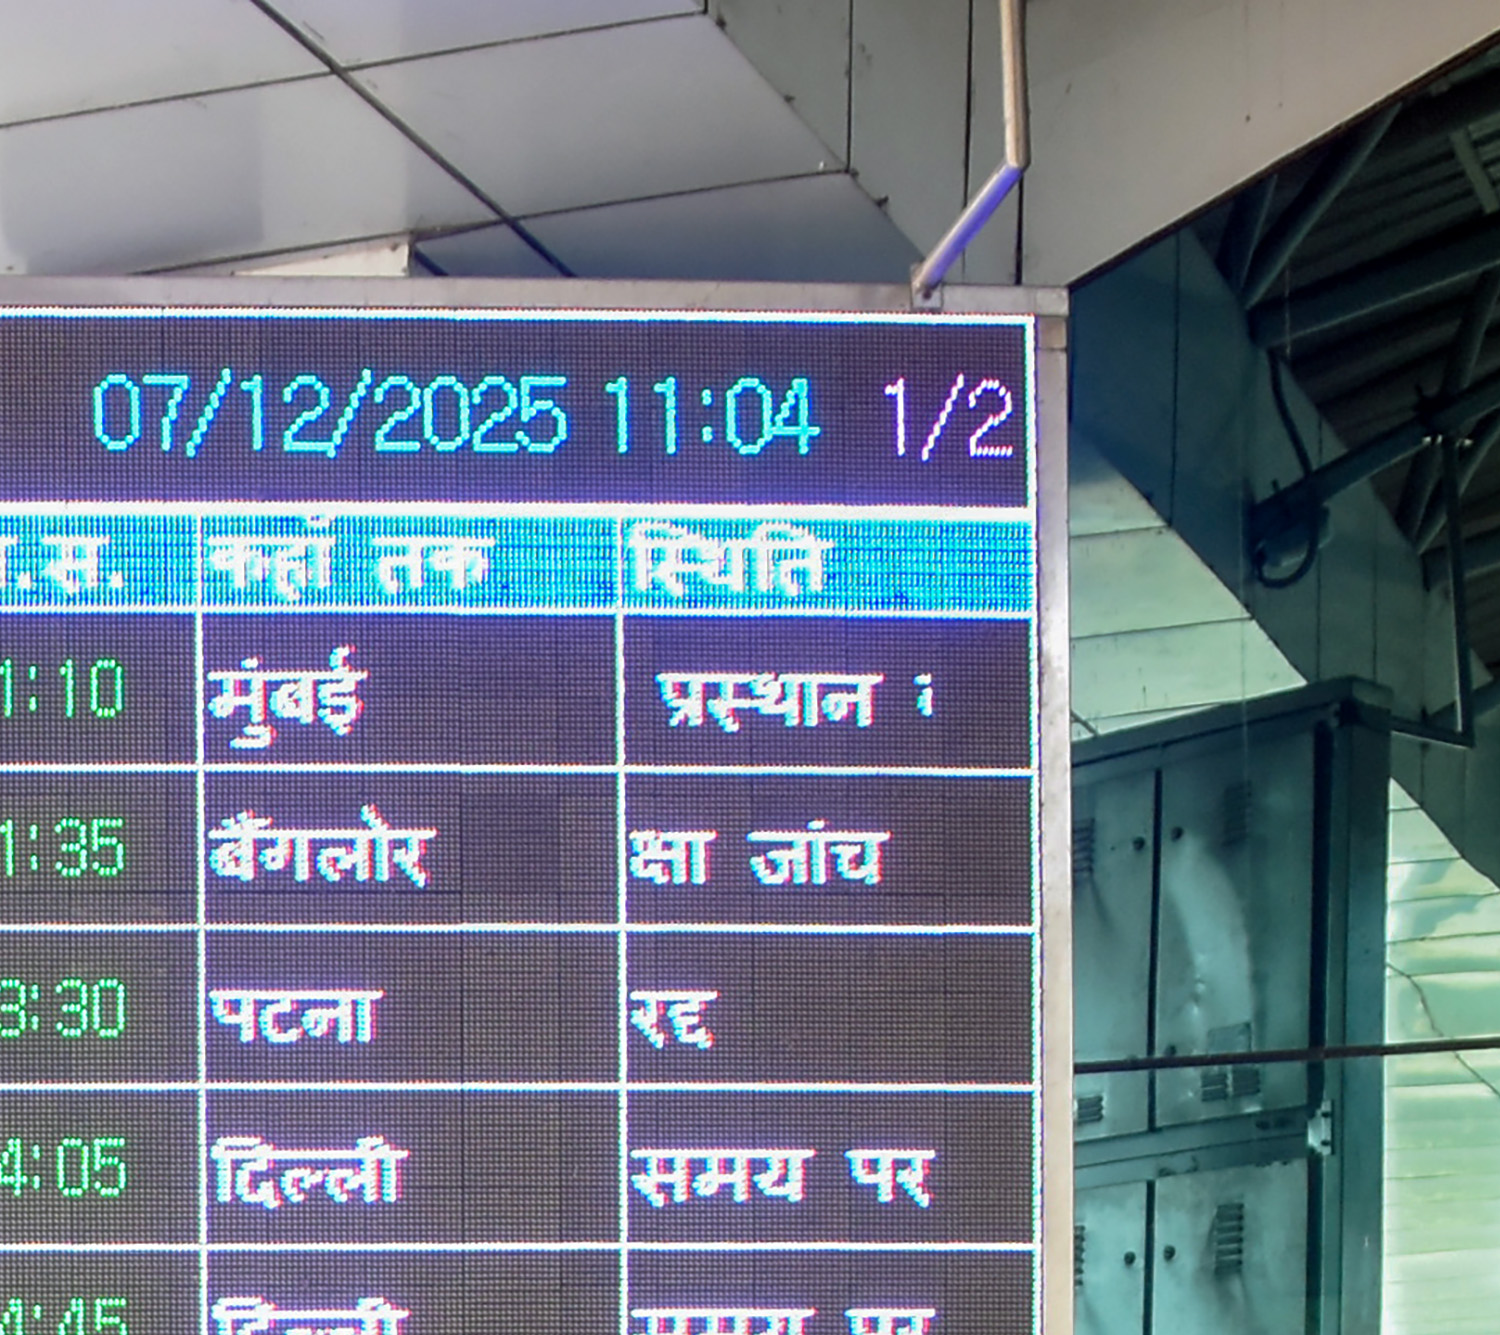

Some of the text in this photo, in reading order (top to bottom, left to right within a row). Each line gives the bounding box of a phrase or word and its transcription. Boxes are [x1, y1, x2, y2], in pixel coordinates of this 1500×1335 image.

[94, 370, 1012, 461] 07/12/2025 11:04 1/2
[371, 538, 495, 594] तक
[629, 522, 832, 599] स्थिति
[207, 647, 367, 749] मुंबई
[655, 673, 883, 732] प्रस्थान
[630, 821, 890, 885] क्षा जांच
[207, 989, 383, 1044] पटना
[630, 991, 718, 1049] रद्द
[210, 1136, 409, 1210] दिल्ली
[631, 1148, 935, 1207] समय पर
